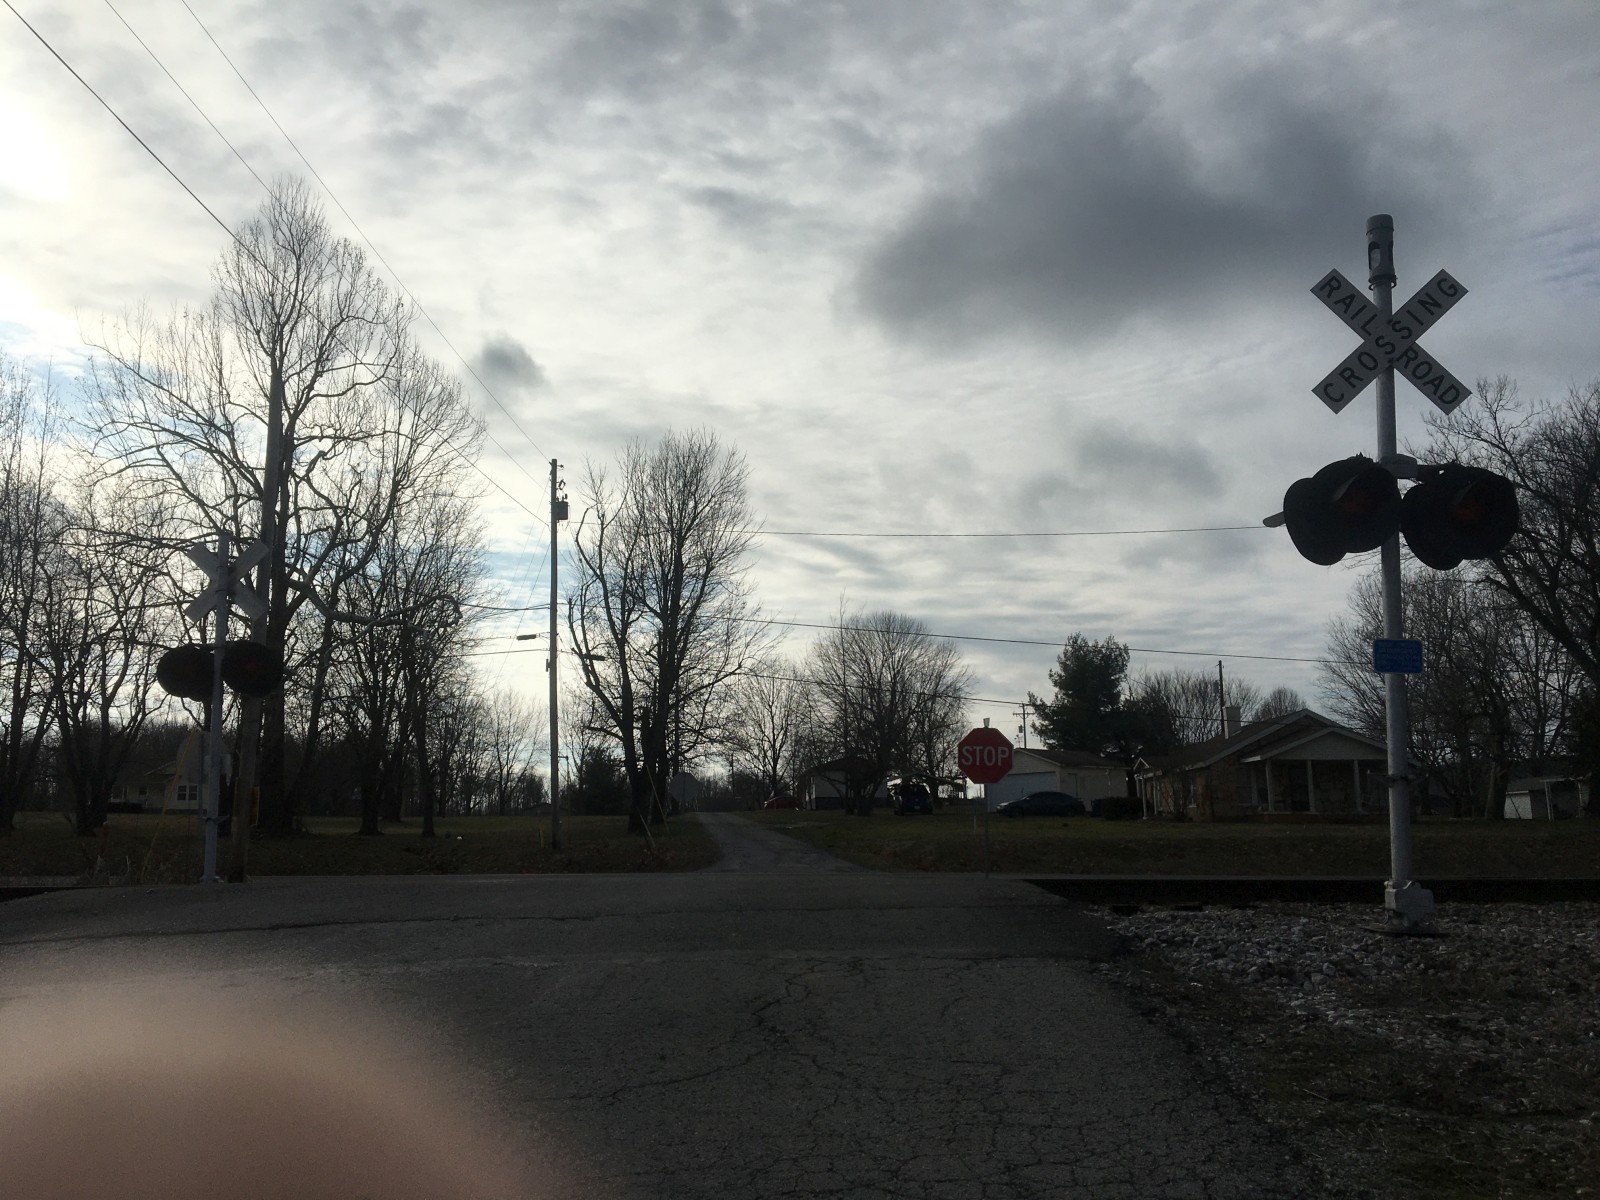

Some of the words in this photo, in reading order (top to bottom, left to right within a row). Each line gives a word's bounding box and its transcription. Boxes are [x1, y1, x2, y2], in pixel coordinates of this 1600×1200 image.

[1319, 275, 1378, 336] RAIL
[1395, 345, 1461, 405] ROAD
[1323, 278, 1459, 403] CROSSING
[961, 745, 1009, 767] STOP
